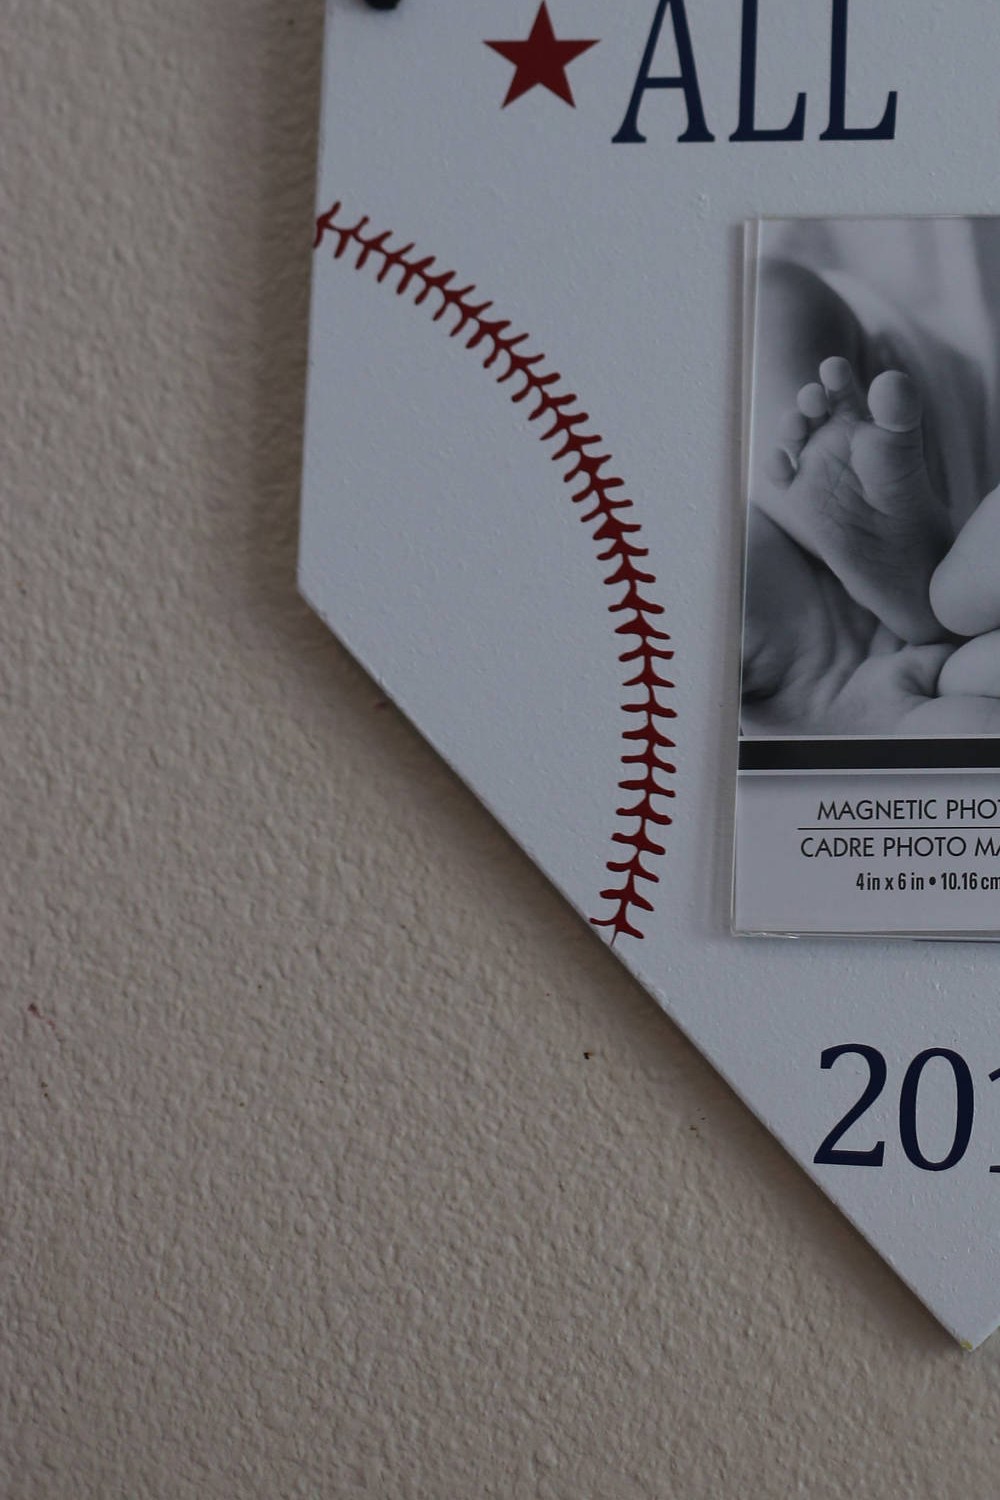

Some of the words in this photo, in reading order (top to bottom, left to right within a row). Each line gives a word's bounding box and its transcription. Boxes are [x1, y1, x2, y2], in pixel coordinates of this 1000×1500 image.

[817, 799, 938, 821] MAGNETIC
[800, 837, 875, 858] CADRE
[883, 836, 967, 857] PHOTO
[884, 877, 894, 891] x
[897, 872, 907, 891] 6
[911, 872, 925, 891] in
[940, 872, 978, 890] 10.16
